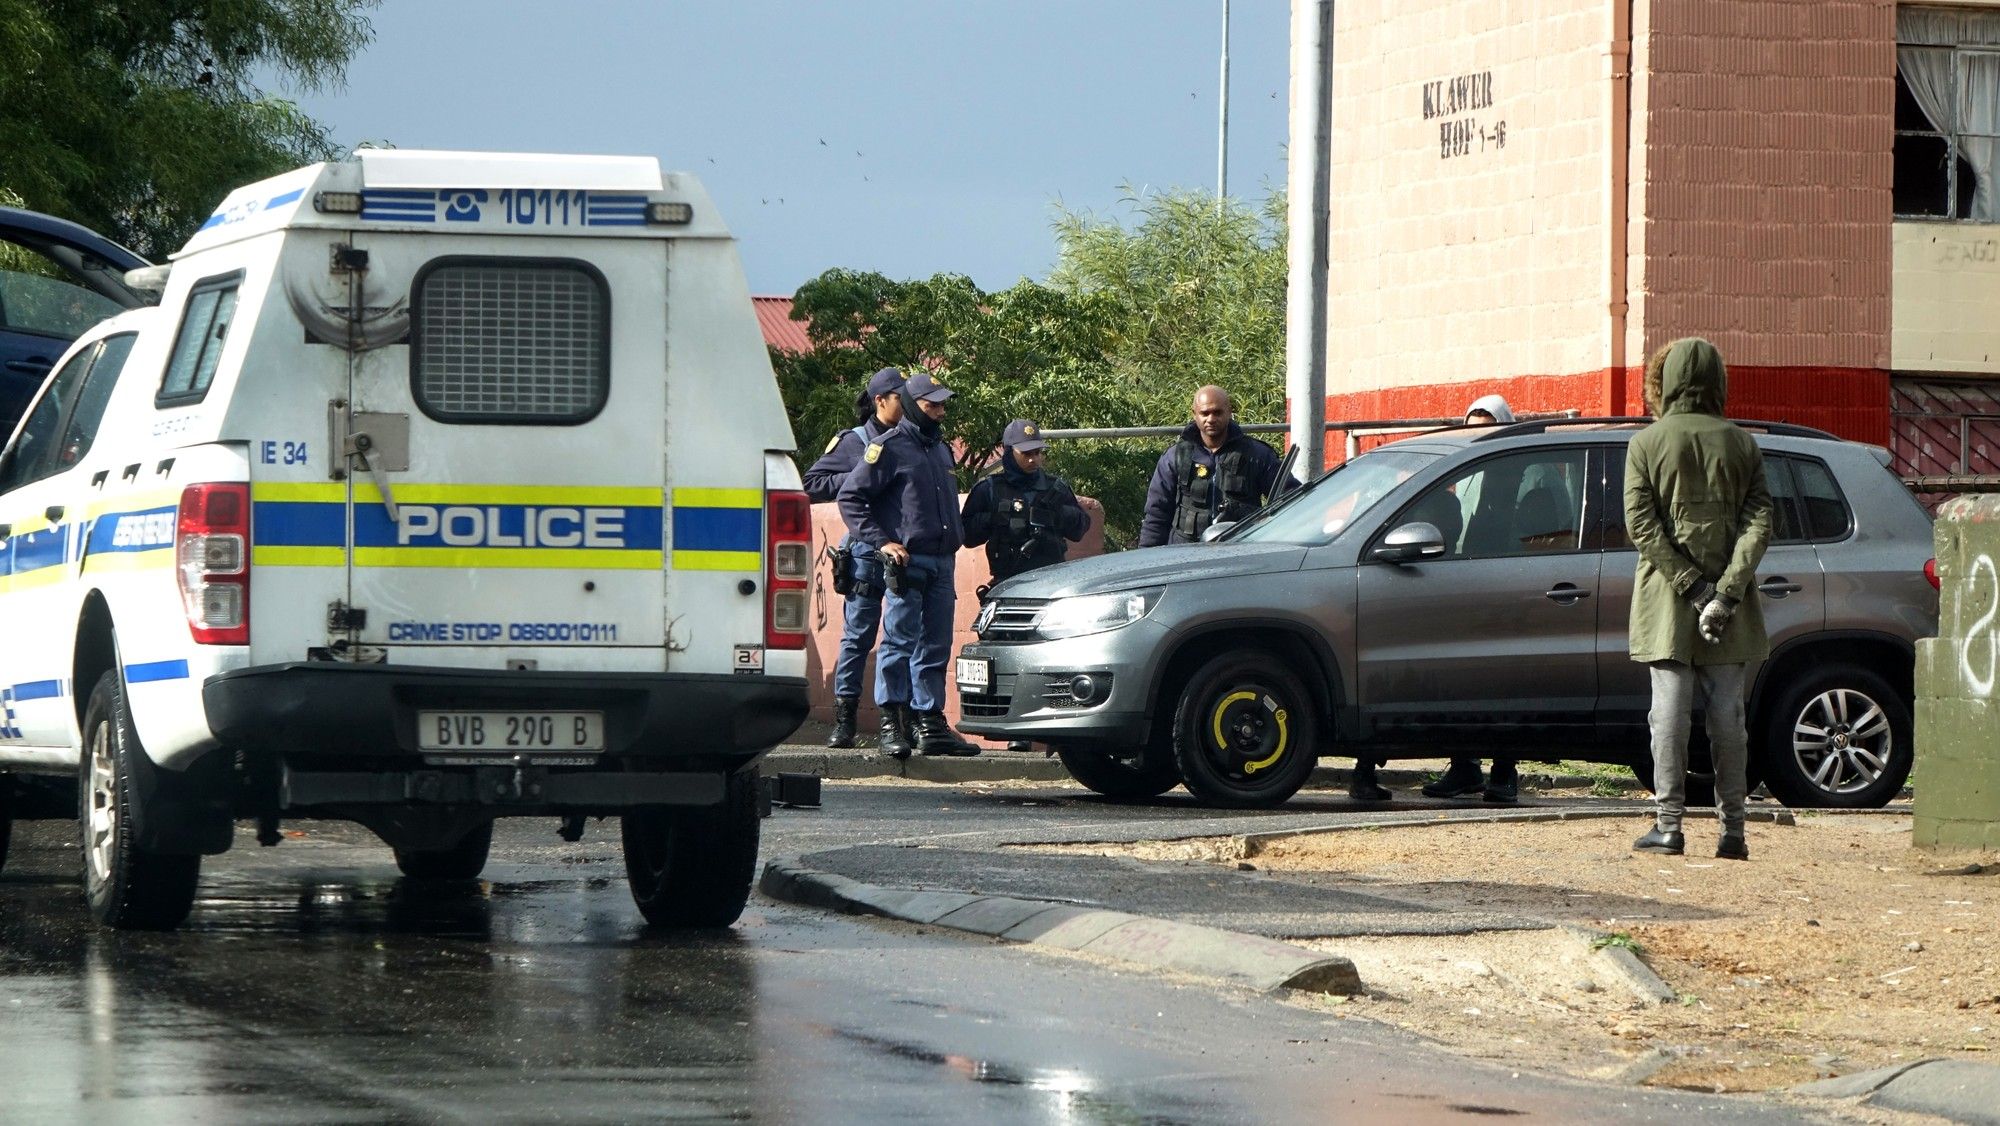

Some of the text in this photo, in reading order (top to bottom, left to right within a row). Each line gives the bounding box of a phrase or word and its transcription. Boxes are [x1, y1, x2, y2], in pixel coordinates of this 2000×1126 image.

[1423, 71, 1493, 120] KLAWER
[1440, 118, 1475, 159] HOF
[499, 189, 586, 226] 10111
[283, 441, 307, 465] 34
[398, 505, 625, 547] POLICE
[389, 622, 617, 642] CRIME STOP 0860010111
[438, 716, 587, 745] BVB 290 B
